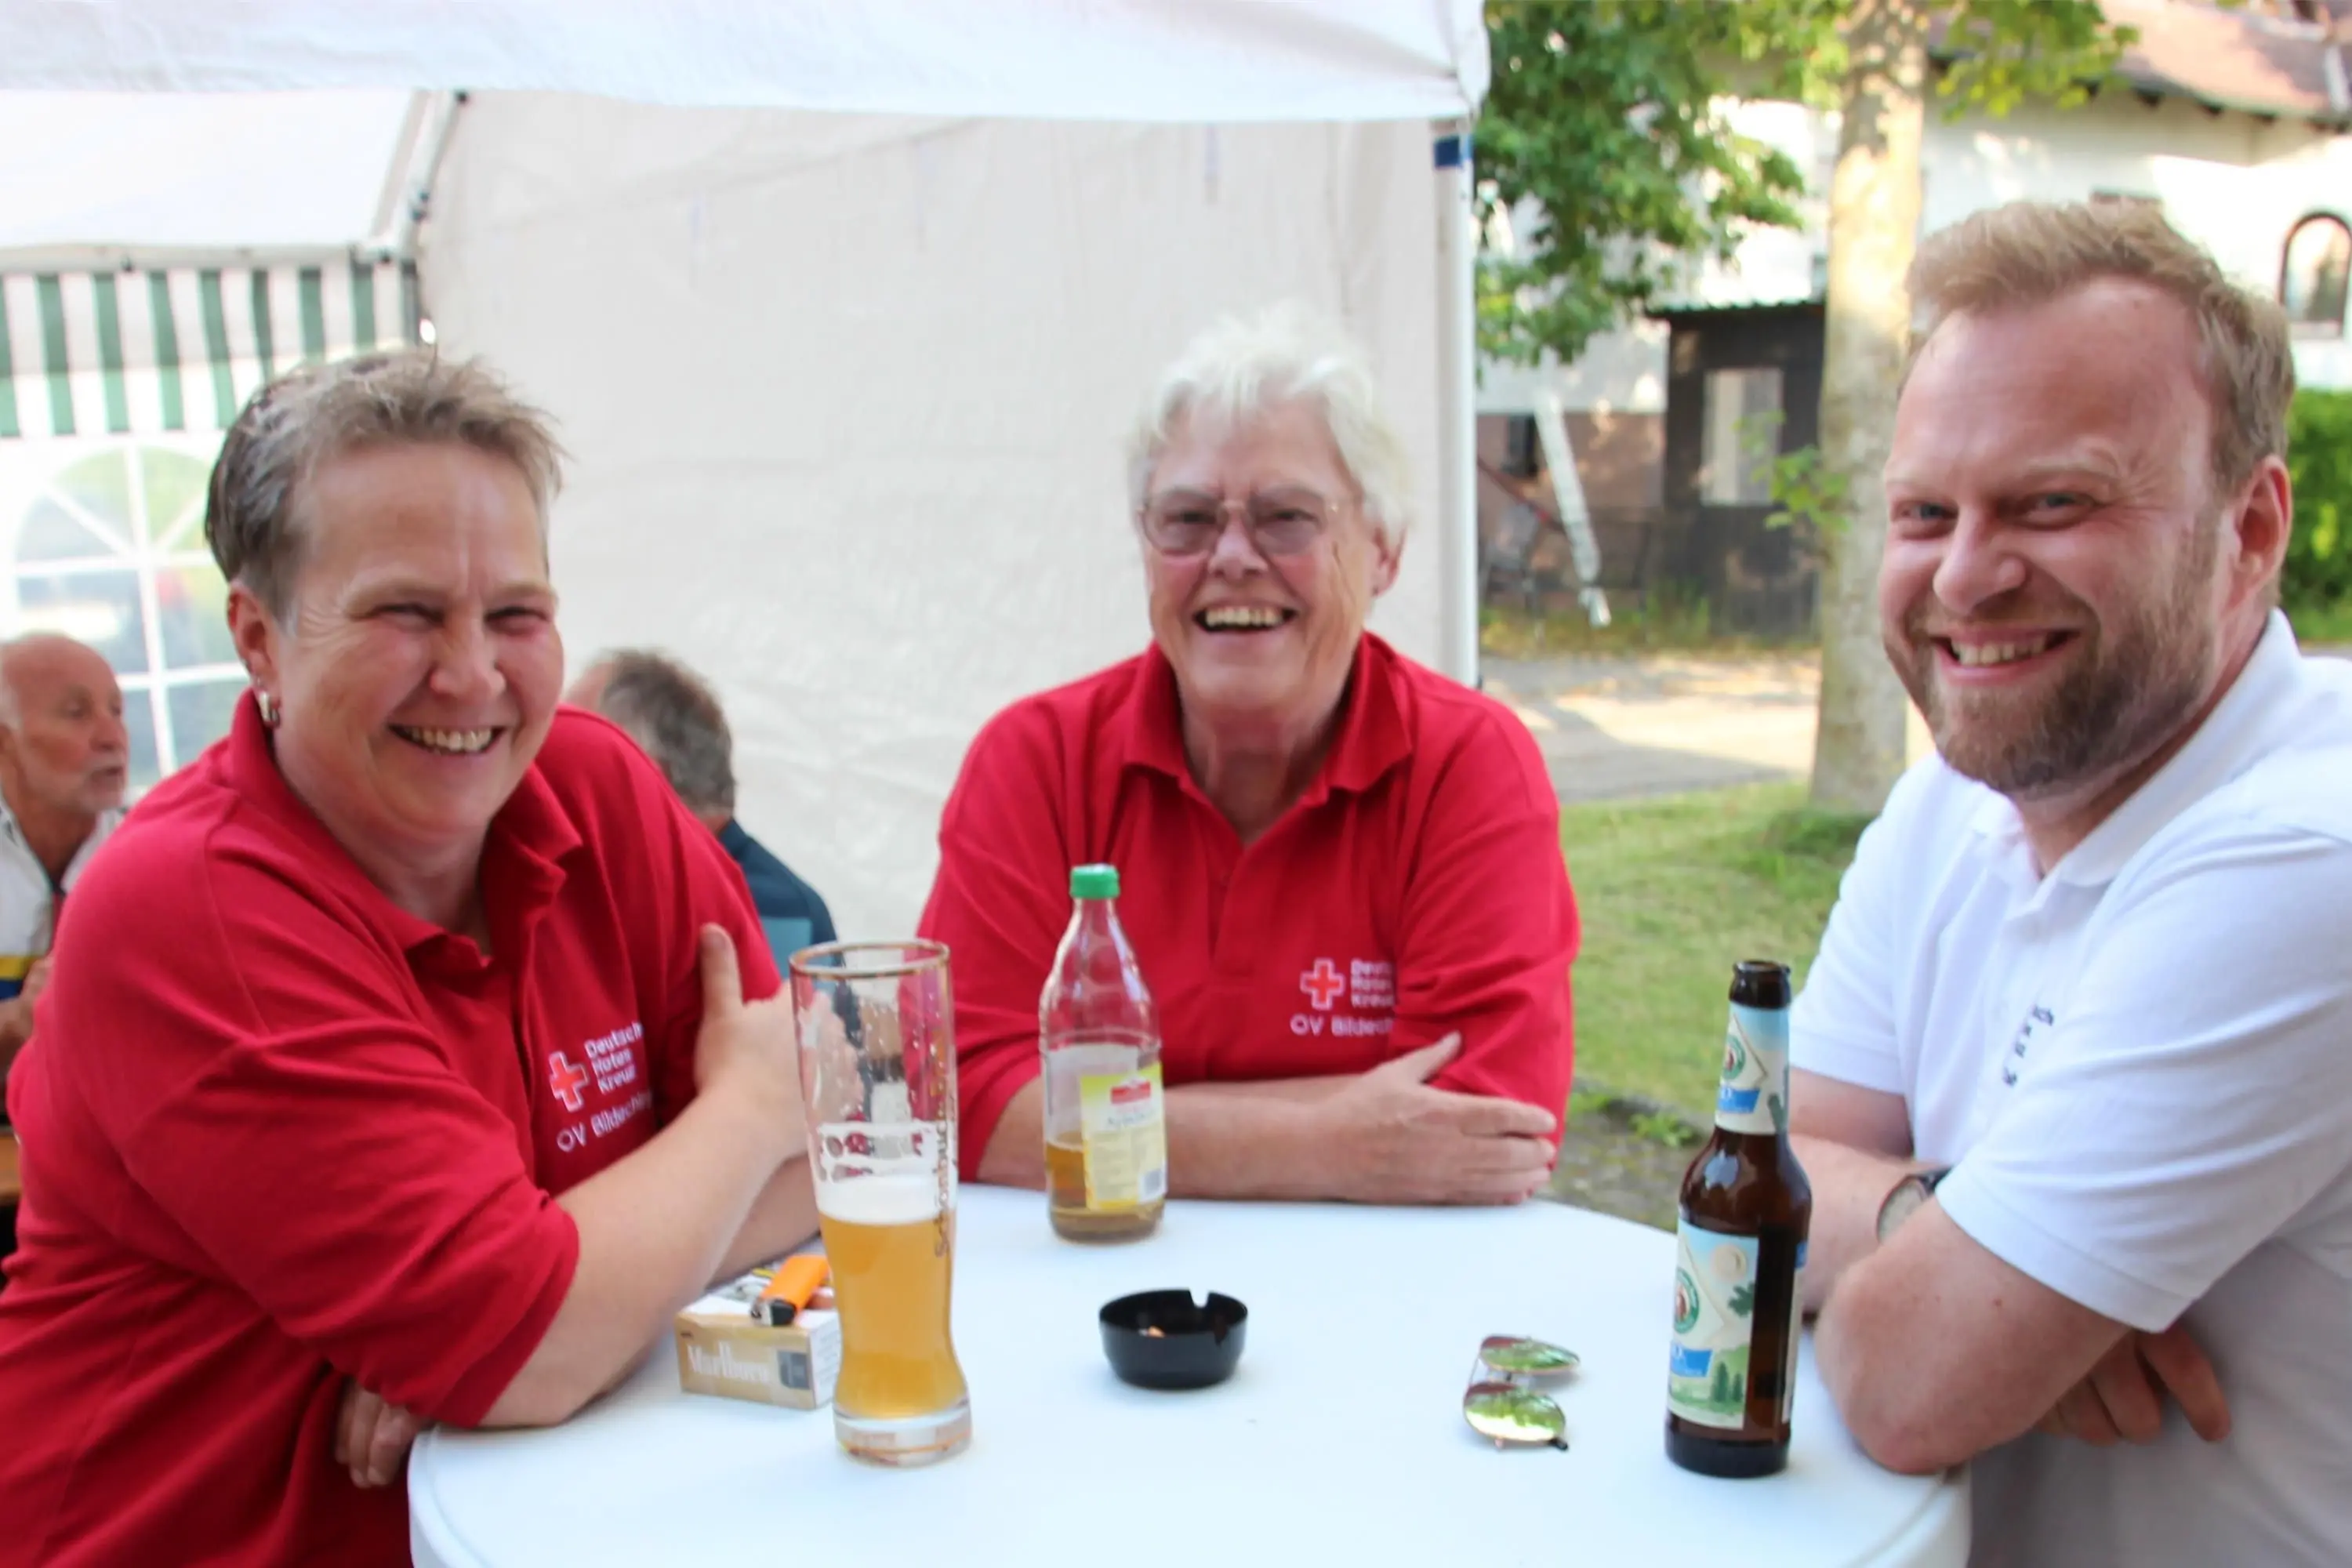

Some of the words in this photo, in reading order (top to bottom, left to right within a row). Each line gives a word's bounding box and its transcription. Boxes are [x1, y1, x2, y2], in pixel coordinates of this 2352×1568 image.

[1290, 1014, 1324, 1036] OV
[584, 1022, 644, 1059] Deutsch
[556, 1122, 586, 1152] OV
